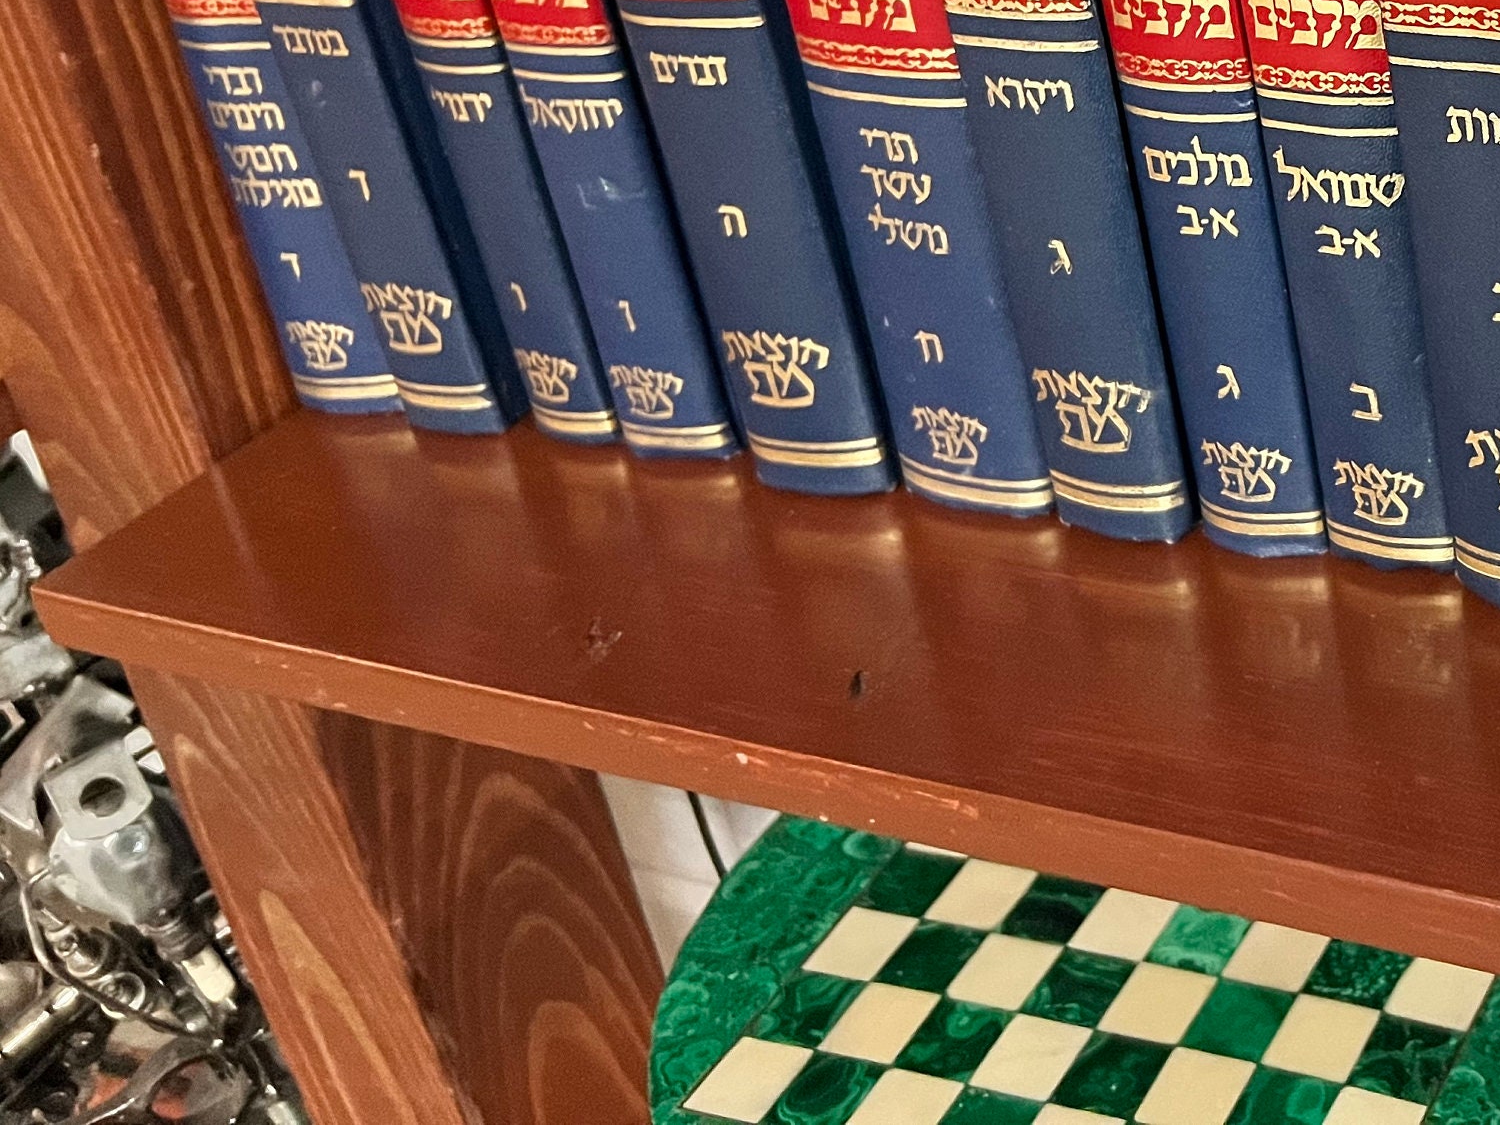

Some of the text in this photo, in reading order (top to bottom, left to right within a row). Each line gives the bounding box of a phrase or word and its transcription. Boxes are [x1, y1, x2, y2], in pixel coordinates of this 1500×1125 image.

[273, 24, 349, 57] במדבר
[202, 64, 263, 96] דברי
[650, 51, 728, 87] דברים
[519, 82, 624, 135] יחזקאל
[985, 74, 1075, 114] ויקרא
[207, 99, 286, 131] הימים
[224, 141, 298, 173] חמש
[859, 127, 919, 165] תרי
[1142, 135, 1253, 187] מלכים
[348, 169, 370, 202] ד
[860, 164, 931, 205] עשר
[1272, 145, 1406, 208] שמואל
[717, 203, 748, 238] ה
[868, 202, 949, 255] משלי
[280, 252, 300, 279] ד
[1047, 238, 1072, 275] ג
[913, 329, 944, 364] ח
[1216, 364, 1241, 400] ג
[1350, 381, 1383, 422] ב
